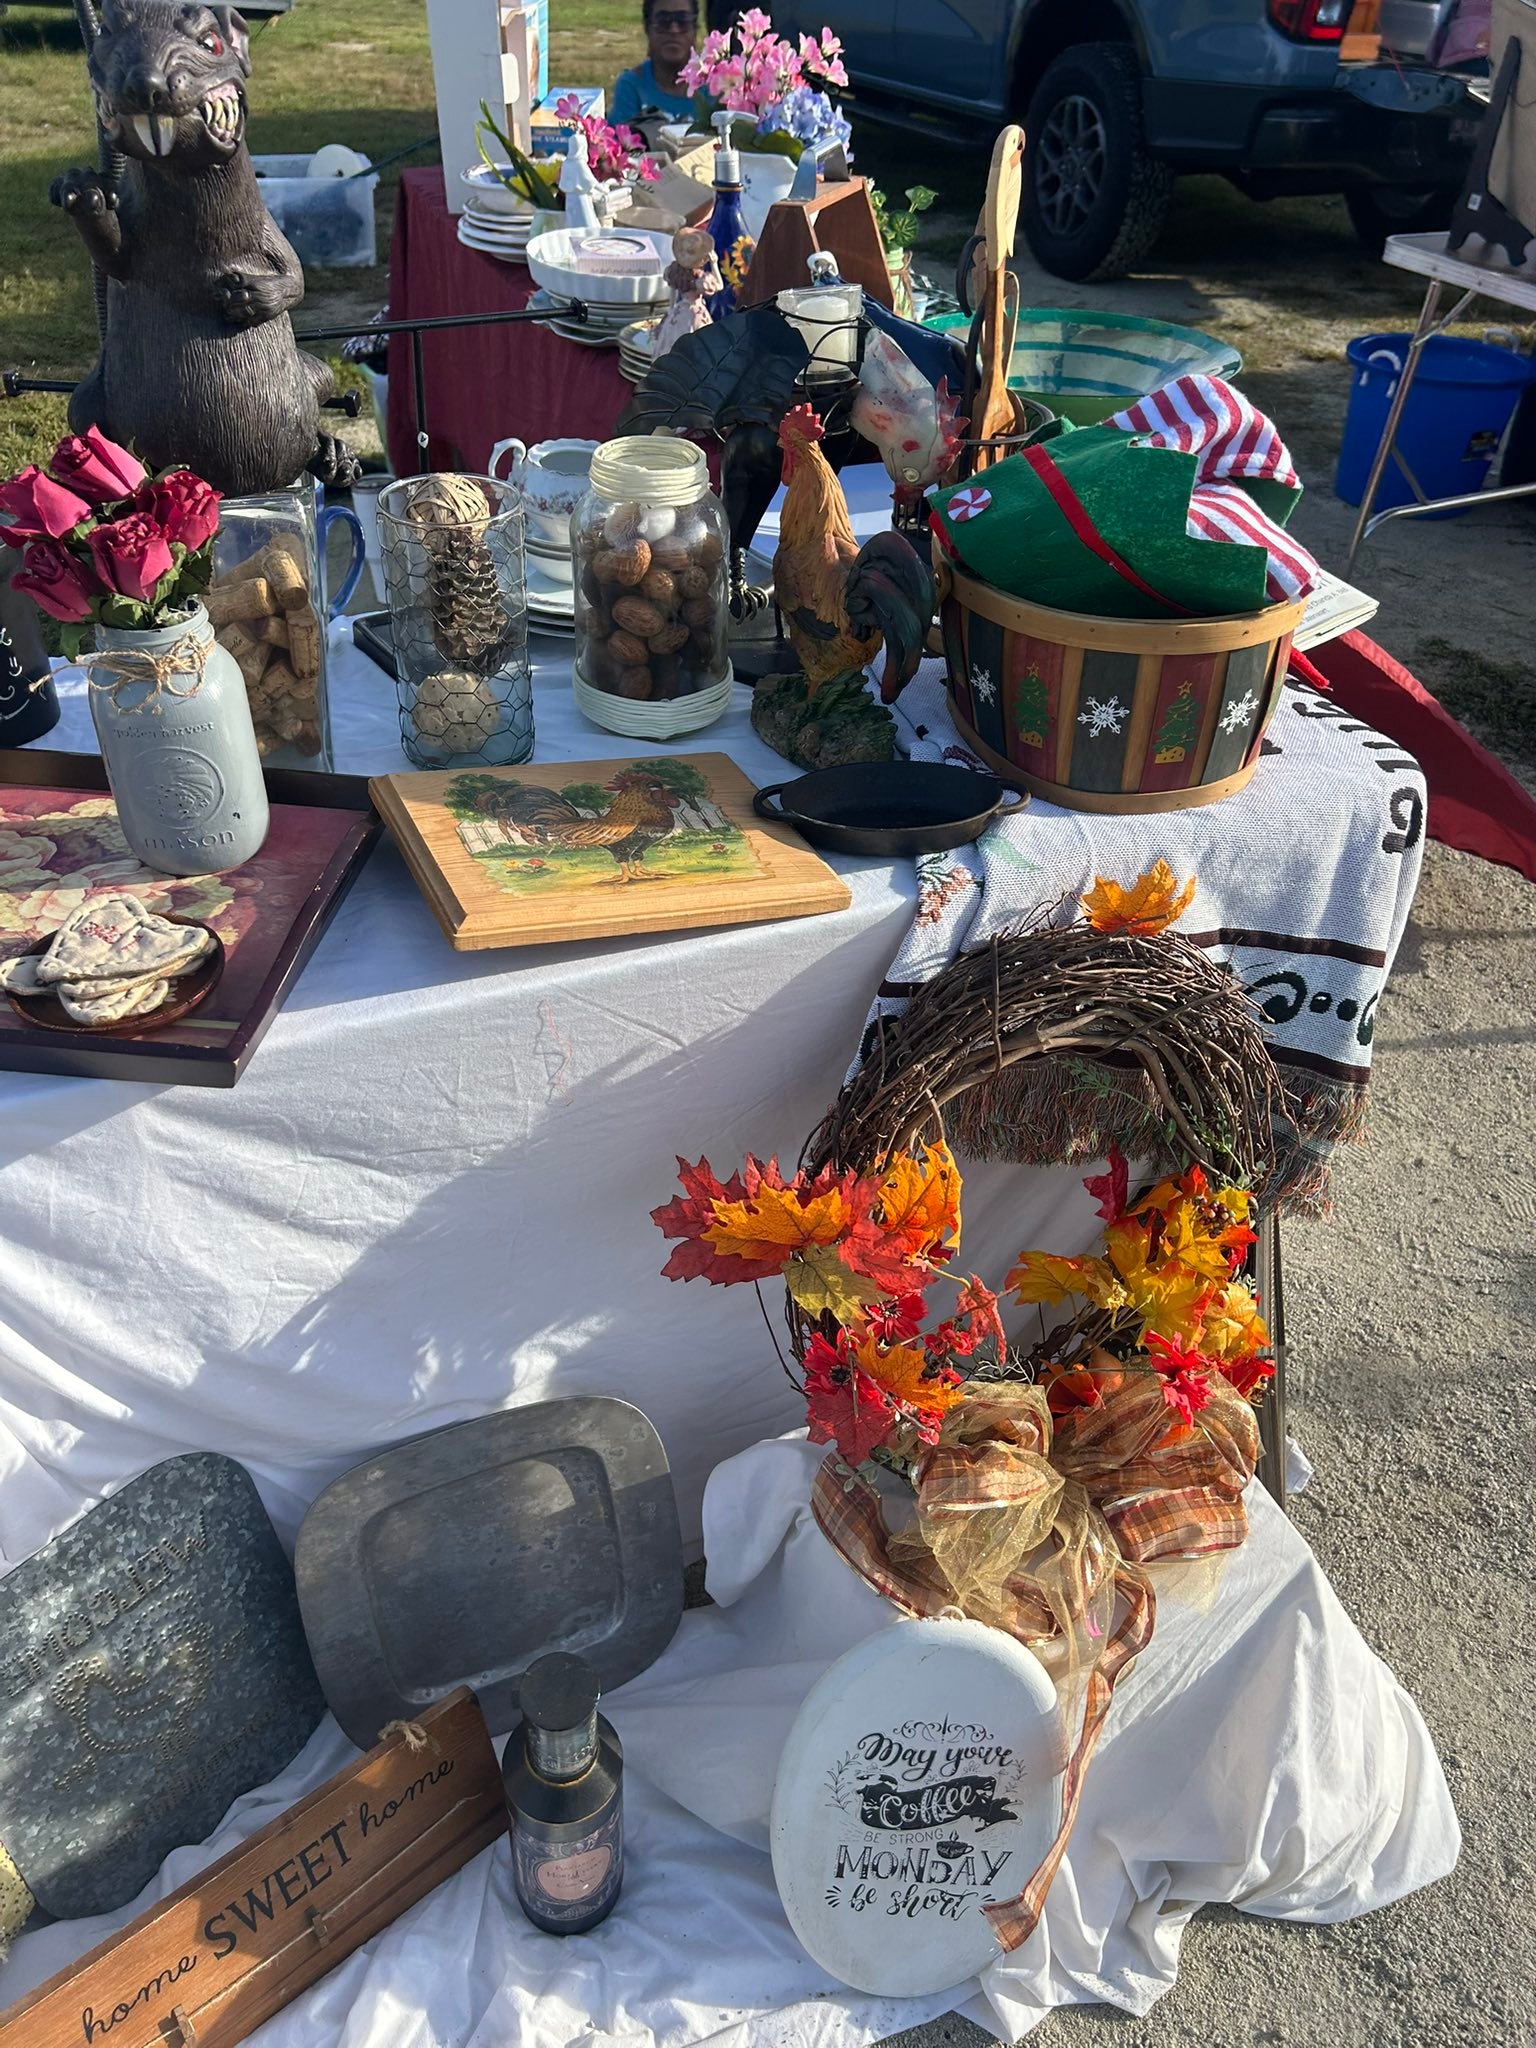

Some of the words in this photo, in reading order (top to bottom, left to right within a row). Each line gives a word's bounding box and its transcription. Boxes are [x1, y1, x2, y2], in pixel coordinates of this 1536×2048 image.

[858, 1733, 937, 1781] May
[940, 1745, 1014, 1777] your
[880, 1785, 976, 1828] Coffee
[863, 1831, 881, 1844] BE
[889, 1828, 944, 1845] STRONG
[834, 1845, 1013, 1887] MONDAY
[82, 1954, 197, 2044] home
[204, 1820, 352, 1961] SWEET
[360, 1760, 454, 1837] home
[849, 1883, 877, 1912] be
[887, 1883, 979, 1921] short
